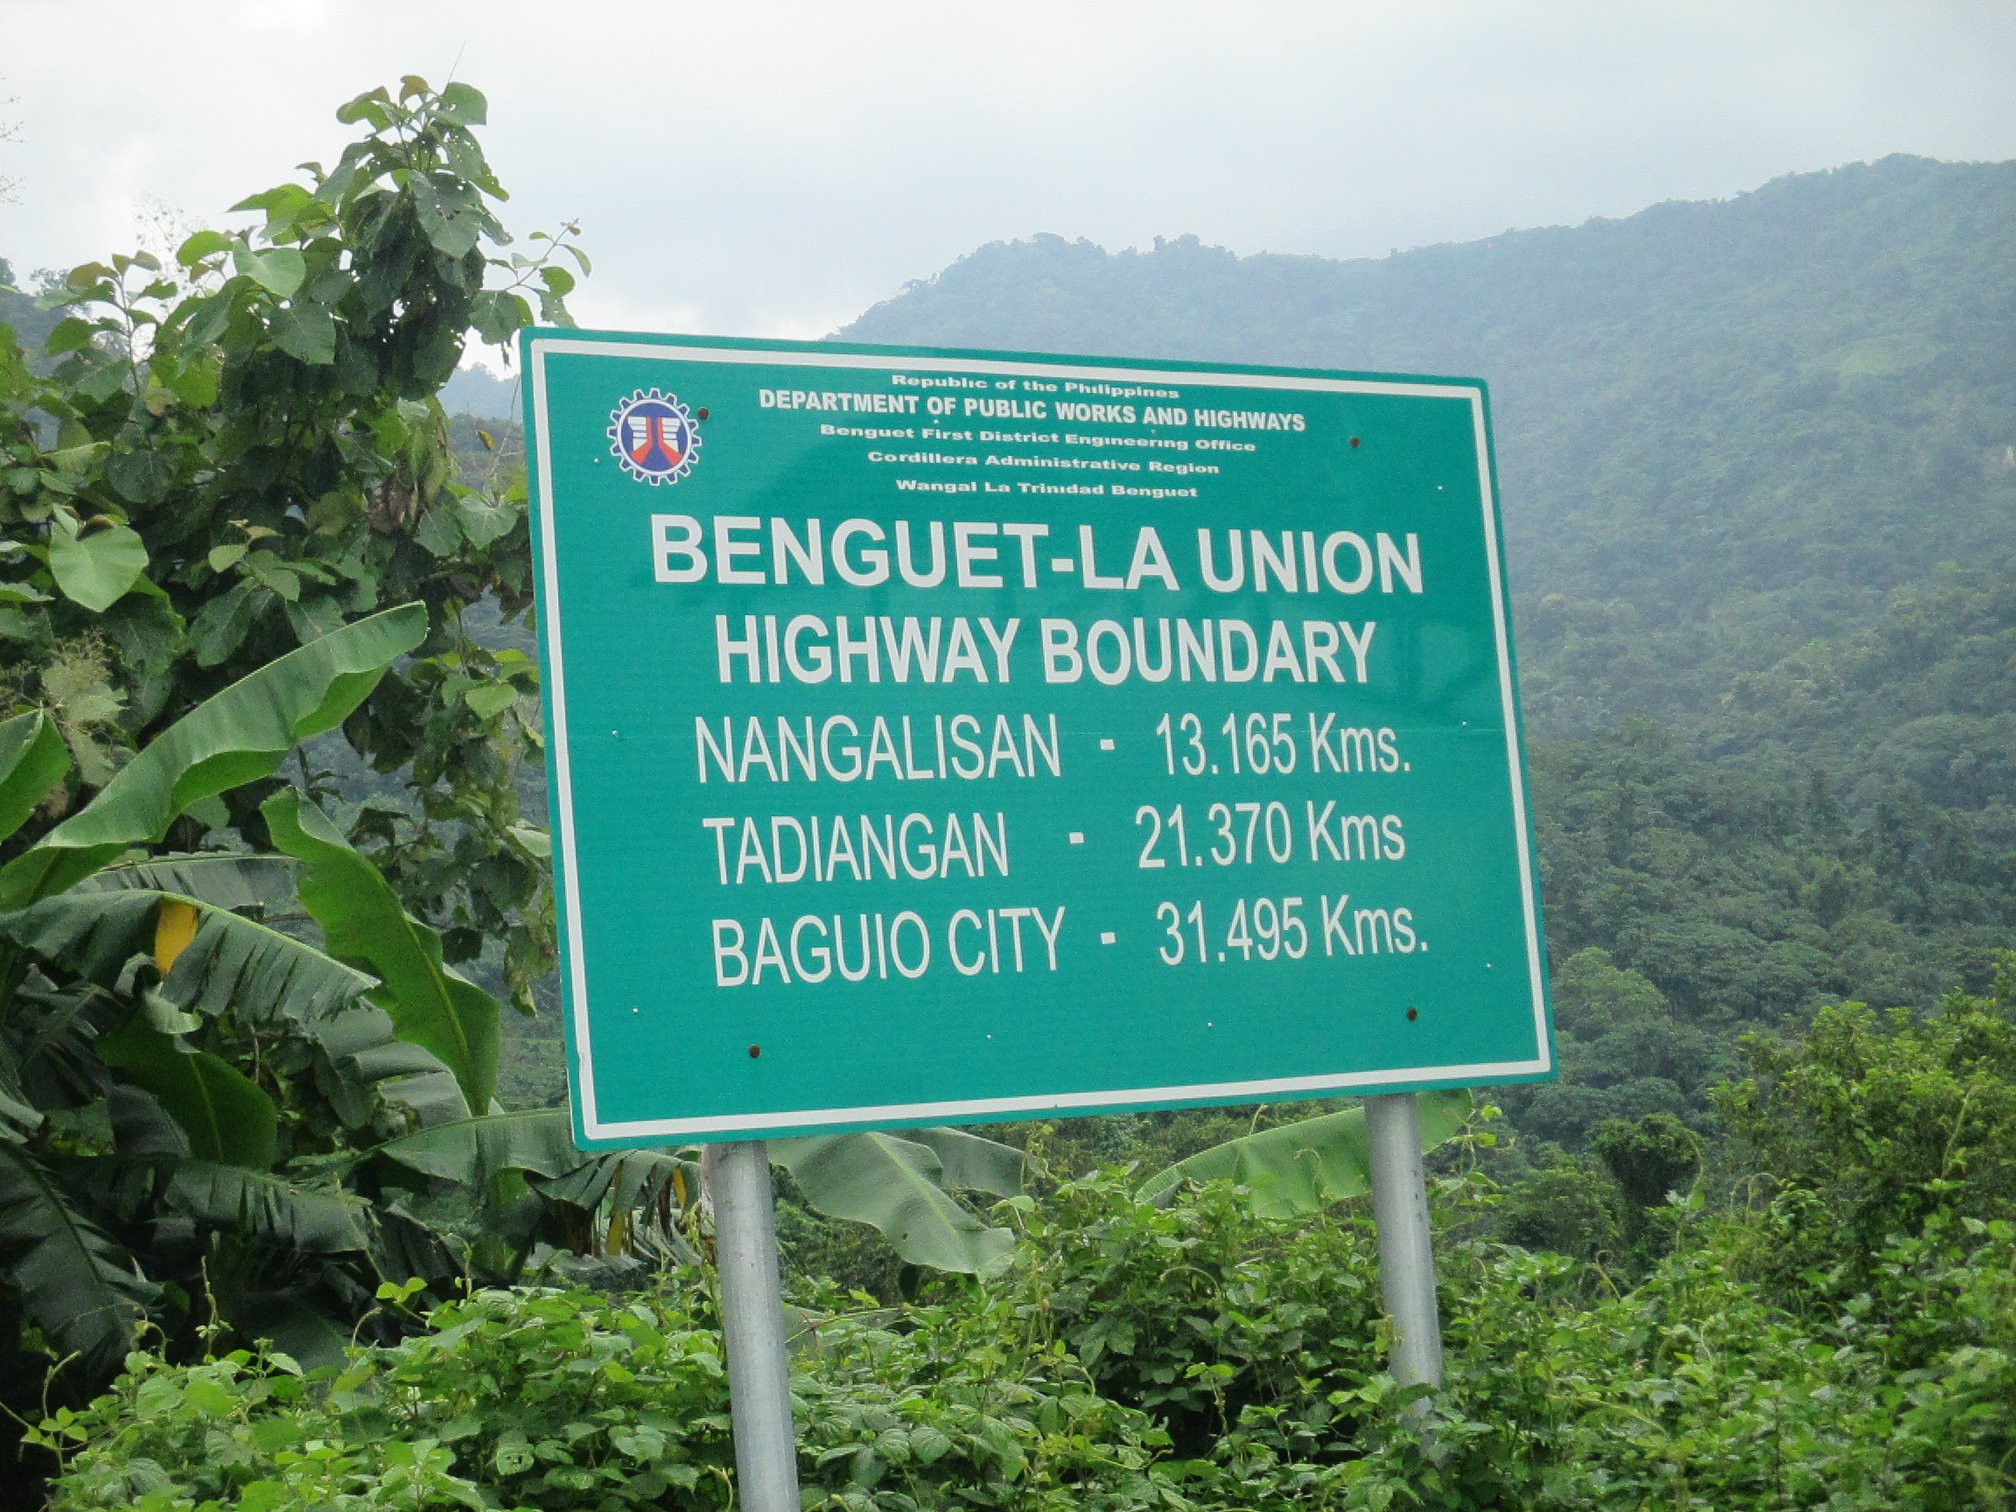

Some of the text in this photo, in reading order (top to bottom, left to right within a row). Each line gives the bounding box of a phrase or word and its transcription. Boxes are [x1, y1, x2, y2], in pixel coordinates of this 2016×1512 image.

[759, 388, 1306, 432] DEPARTMENT OF PUBLIC WORKS AND HIGHWAYS
[891, 374, 1181, 399] Republic of the Philippines
[820, 423, 1256, 452] Benguet First District Engineering Office
[867, 451, 1220, 475] Cordillera Administrative Region
[895, 479, 1198, 499] Wangal La Trinidad Benguet
[651, 514, 1422, 594] BENGUET-LA UNION
[716, 615, 1375, 685] HIGHWAY BOUNDARY
[696, 713, 1410, 783] NANGALISAN - 13.165 Kms.
[703, 801, 1405, 884] TADIANGAN - 21.370 Kms
[712, 895, 1427, 986] BAGUIO CITY - 31.495 Kms.
